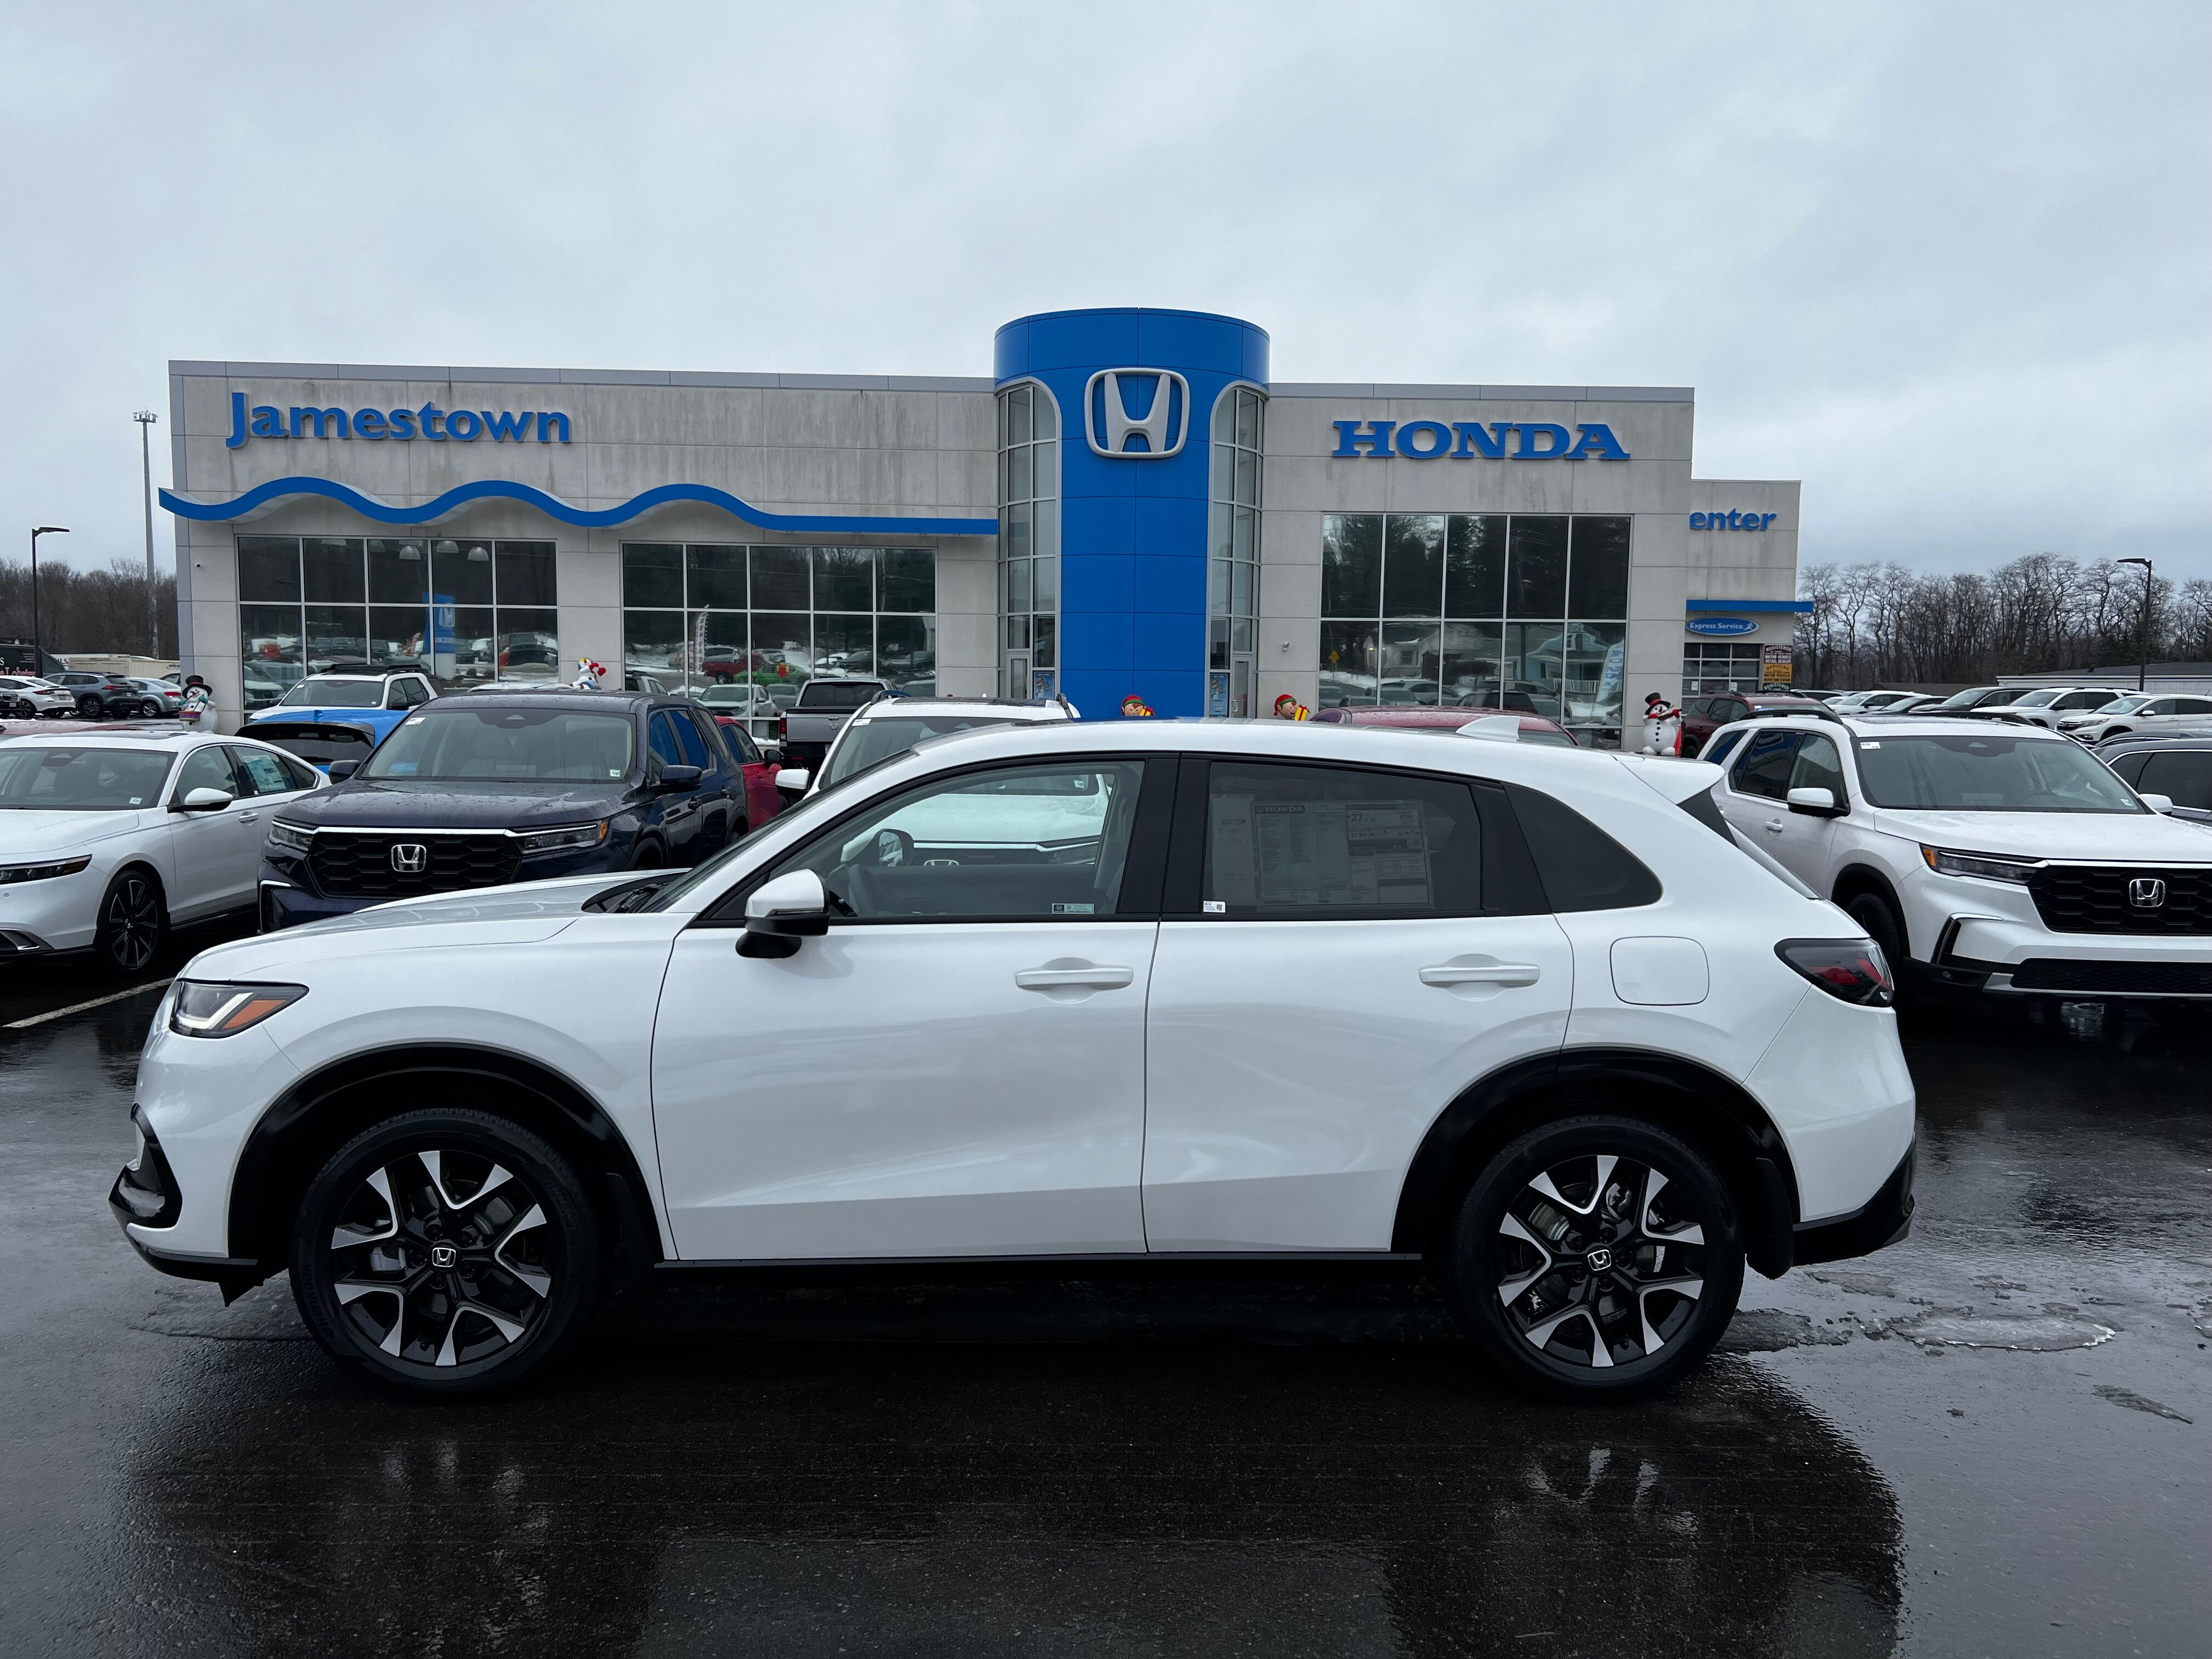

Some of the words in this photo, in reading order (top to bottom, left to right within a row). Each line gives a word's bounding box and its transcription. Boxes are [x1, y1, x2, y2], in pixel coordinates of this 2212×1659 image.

[225, 392, 571, 449] Jamestown
[1331, 420, 1630, 460] HONDA
[1689, 508, 1777, 531] enter
[1351, 814, 1362, 822] 27
